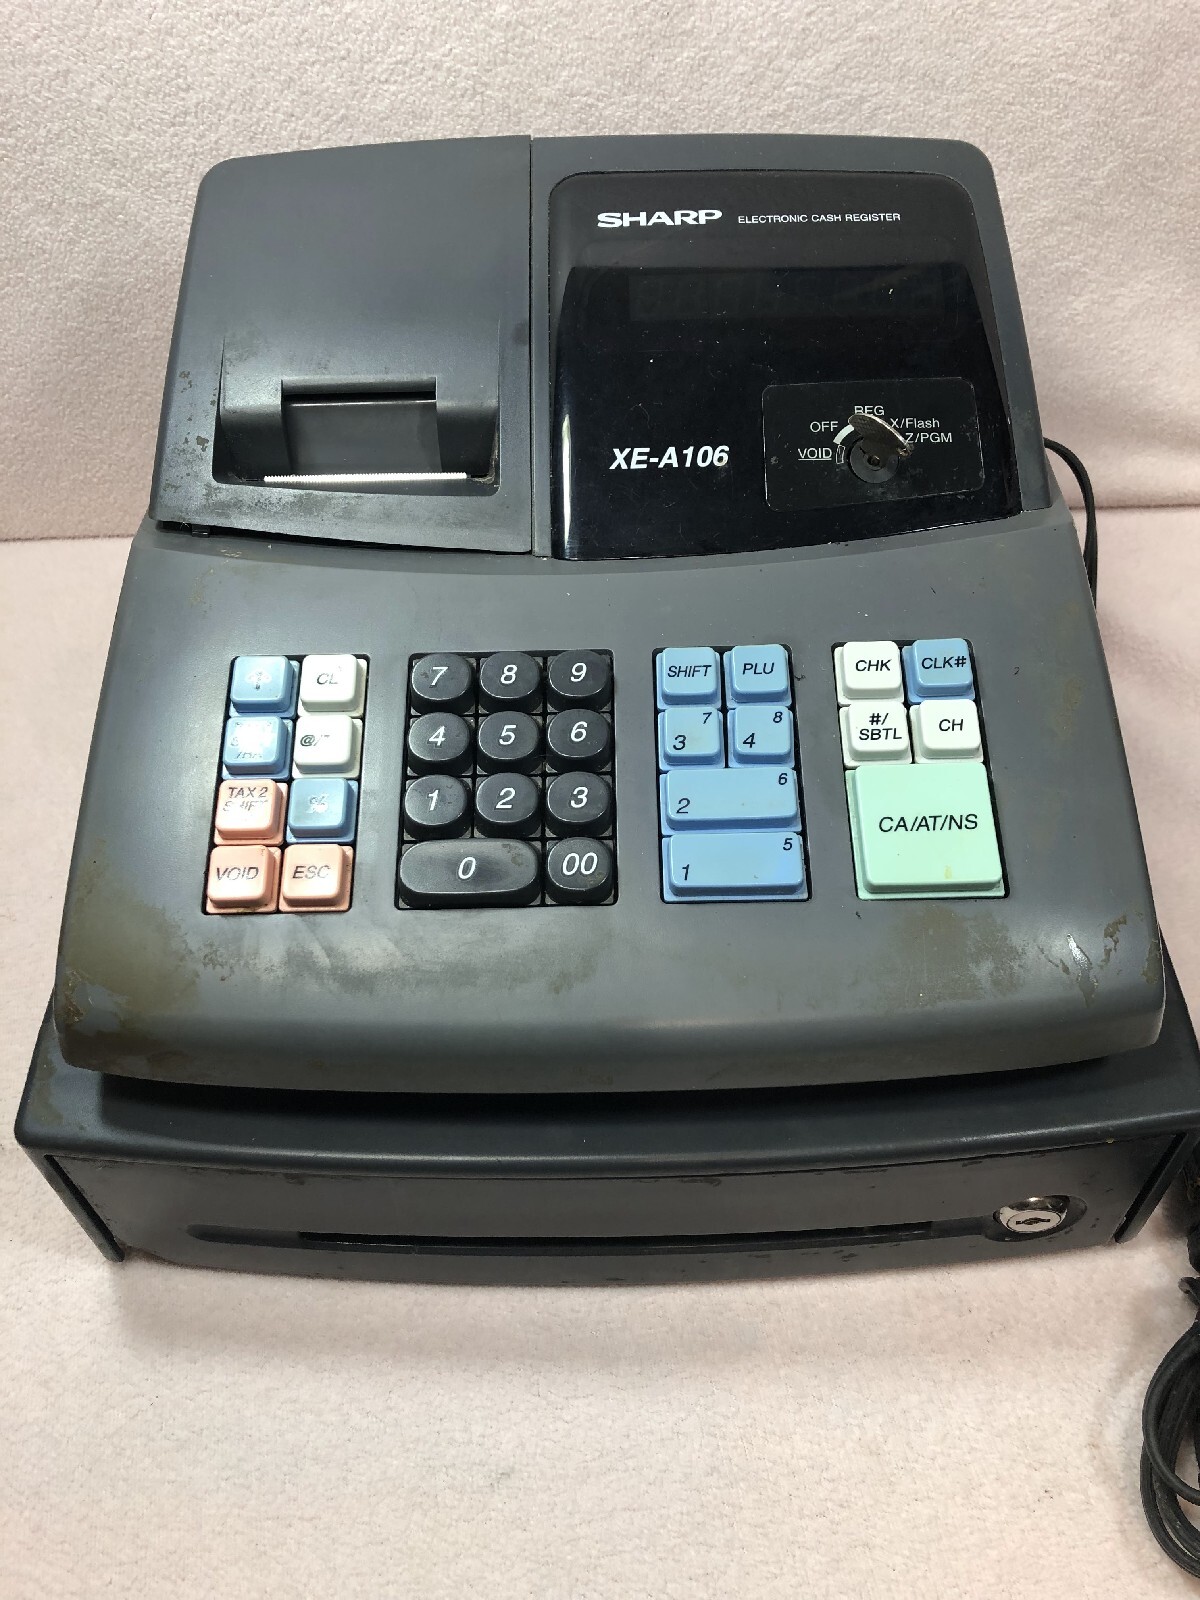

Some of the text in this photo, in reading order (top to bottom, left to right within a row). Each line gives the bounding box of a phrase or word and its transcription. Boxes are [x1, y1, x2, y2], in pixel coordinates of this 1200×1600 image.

[597, 209, 722, 228] SHARP
[738, 213, 901, 224] ELECTRONIC CASH REGISTER
[810, 421, 839, 432] OFF
[890, 417, 940, 429] X/Flash
[905, 432, 952, 445] Z/PGM
[608, 445, 730, 470] XE-A106
[798, 447, 832, 460] VOID
[743, 662, 775, 675] PLU
[855, 659, 892, 672] CHK
[921, 655, 967, 670] CLK#
[430, 666, 448, 686] 7
[500, 664, 517, 684] 8
[570, 662, 587, 682] 9
[667, 664, 712, 678] SHIFT
[702, 711, 713, 725] 7
[773, 711, 783, 724] 8
[868, 712, 889, 726] #/
[939, 718, 964, 732] CH
[429, 725, 446, 747] 4
[499, 724, 517, 745] 5
[570, 721, 588, 742] 6
[859, 728, 903, 741] SBTL
[673, 734, 687, 751] 3
[743, 732, 756, 749] 4
[778, 772, 788, 786] 6
[228, 786, 257, 798] TAX
[495, 787, 516, 809] 2
[570, 786, 589, 809] 3
[428, 789, 439, 811] 1
[676, 797, 691, 814] 2
[878, 813, 978, 833] CA/AT/NS
[782, 838, 793, 851] 5
[458, 857, 476, 879] 0
[562, 852, 598, 876] 00
[216, 867, 259, 881] VOID
[292, 865, 331, 879] ESC
[681, 863, 690, 881] 1
